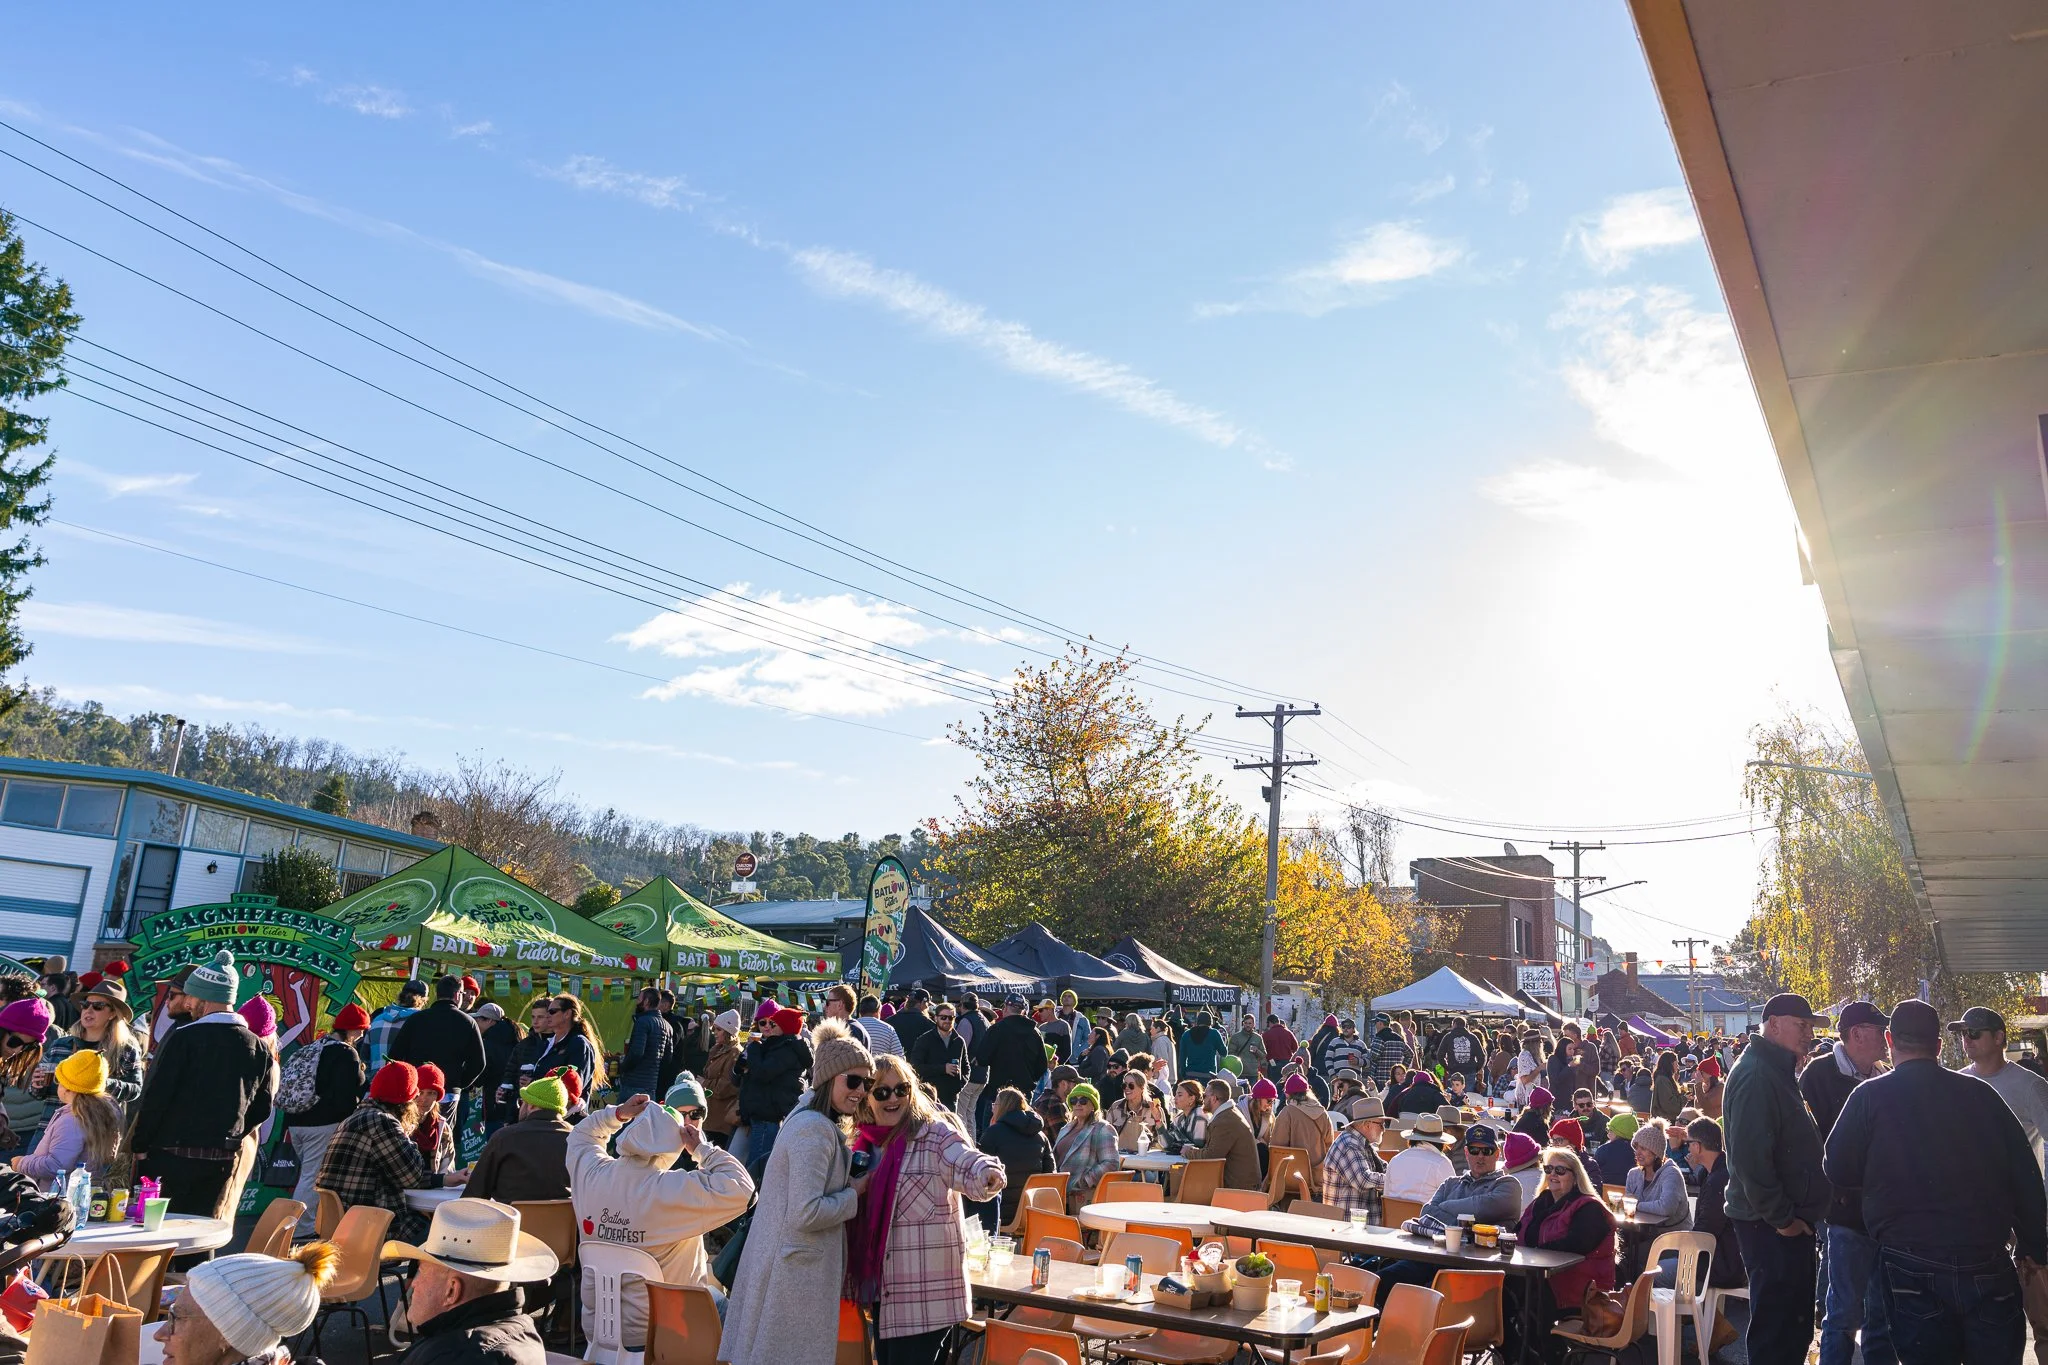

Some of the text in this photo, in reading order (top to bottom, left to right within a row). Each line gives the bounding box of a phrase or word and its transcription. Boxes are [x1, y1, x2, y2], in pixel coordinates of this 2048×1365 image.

[152, 907, 347, 941] MAGNIFICENT
[207, 924, 288, 937] BATLOW Cider
[141, 940, 342, 978] SPECTACULAR
[431, 934, 508, 958] BATLOW
[513, 939, 559, 962] Cider
[677, 949, 732, 969] BATLOW
[737, 949, 769, 972] Cider
[790, 956, 837, 975] BATLOW
[1179, 986, 1210, 1002] DARKES
[1211, 987, 1236, 1003] CIDER
[600, 1207, 631, 1226] Batlow
